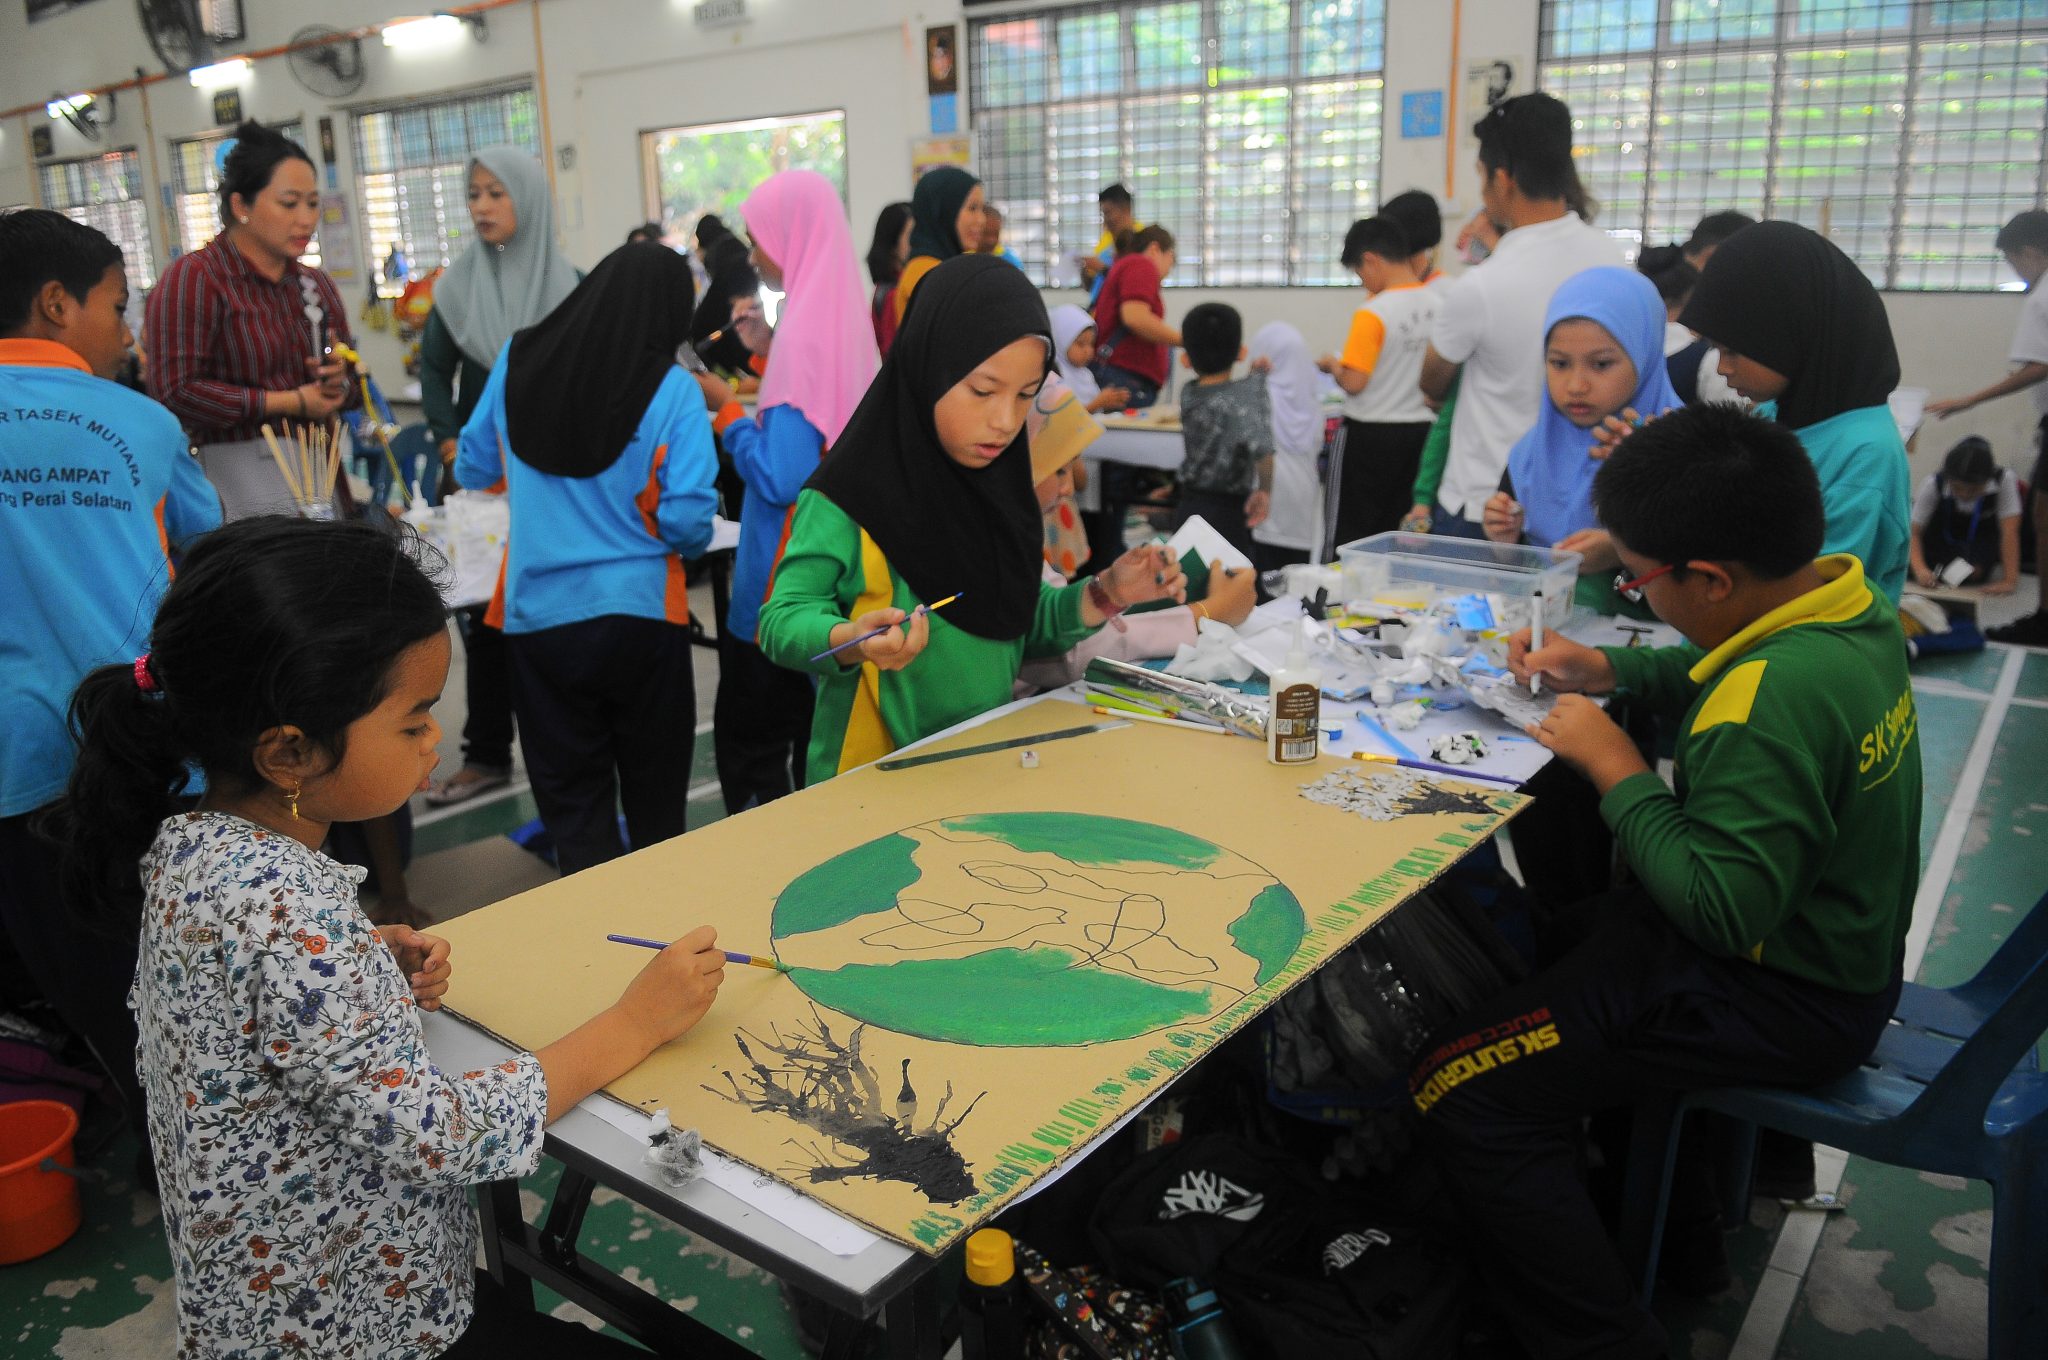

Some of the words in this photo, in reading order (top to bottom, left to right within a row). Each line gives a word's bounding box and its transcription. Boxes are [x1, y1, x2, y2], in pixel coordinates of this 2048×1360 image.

[14, 408, 83, 426] TASEK
[86, 420, 142, 487] MUTIARA
[0, 467, 42, 484] ANG
[46, 466, 111, 484] AMPAT
[22, 490, 67, 507] Perai
[72, 491, 132, 512] Selatan
[1516, 1022, 1561, 1057] SK
